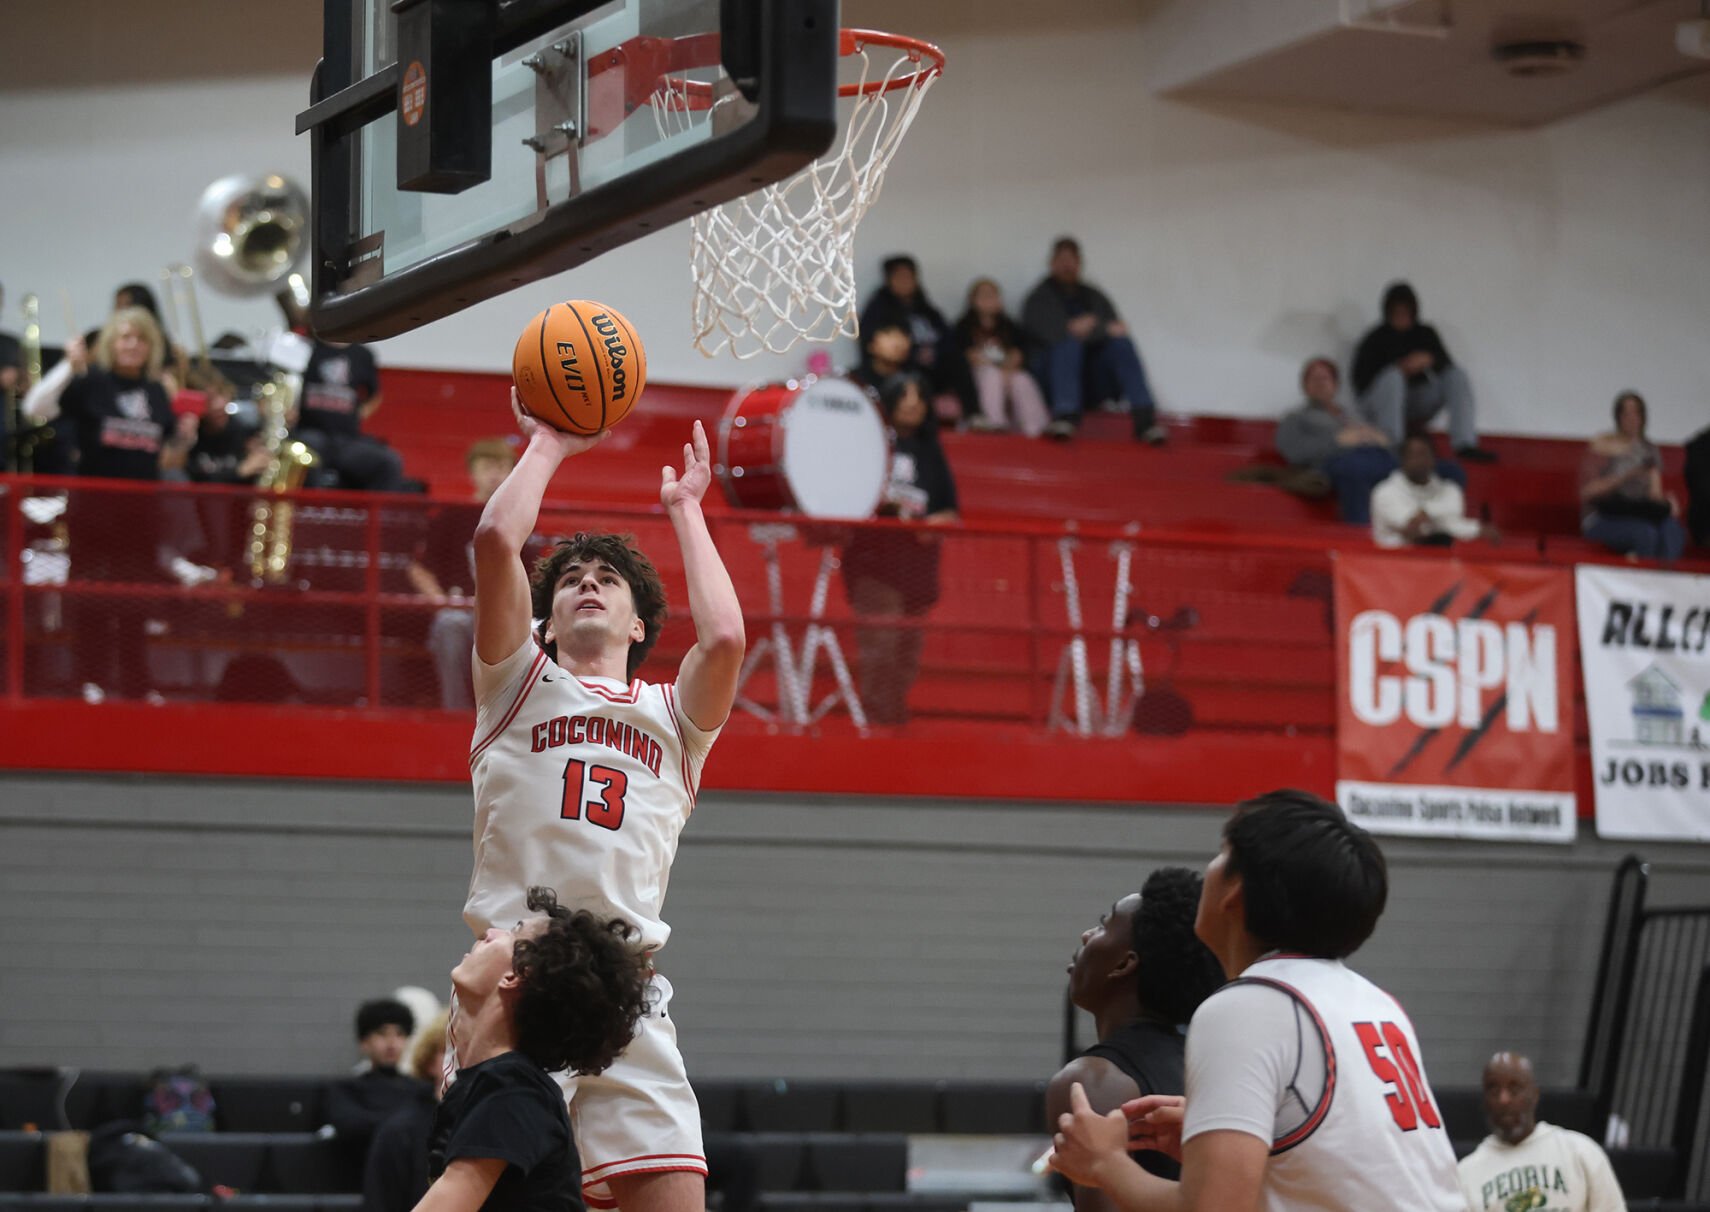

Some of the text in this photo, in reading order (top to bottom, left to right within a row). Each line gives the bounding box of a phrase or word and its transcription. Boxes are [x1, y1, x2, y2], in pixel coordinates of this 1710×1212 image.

[556, 341, 588, 392] EVO
[590, 312, 627, 402] Wilson
[1349, 609, 1558, 734] CSPN
[531, 715, 663, 779] COCONINO
[1600, 757, 1690, 788] JOBS
[560, 758, 628, 831] 13
[1351, 1021, 1441, 1132] 50
[1482, 1164, 1568, 1210] PEORIA
